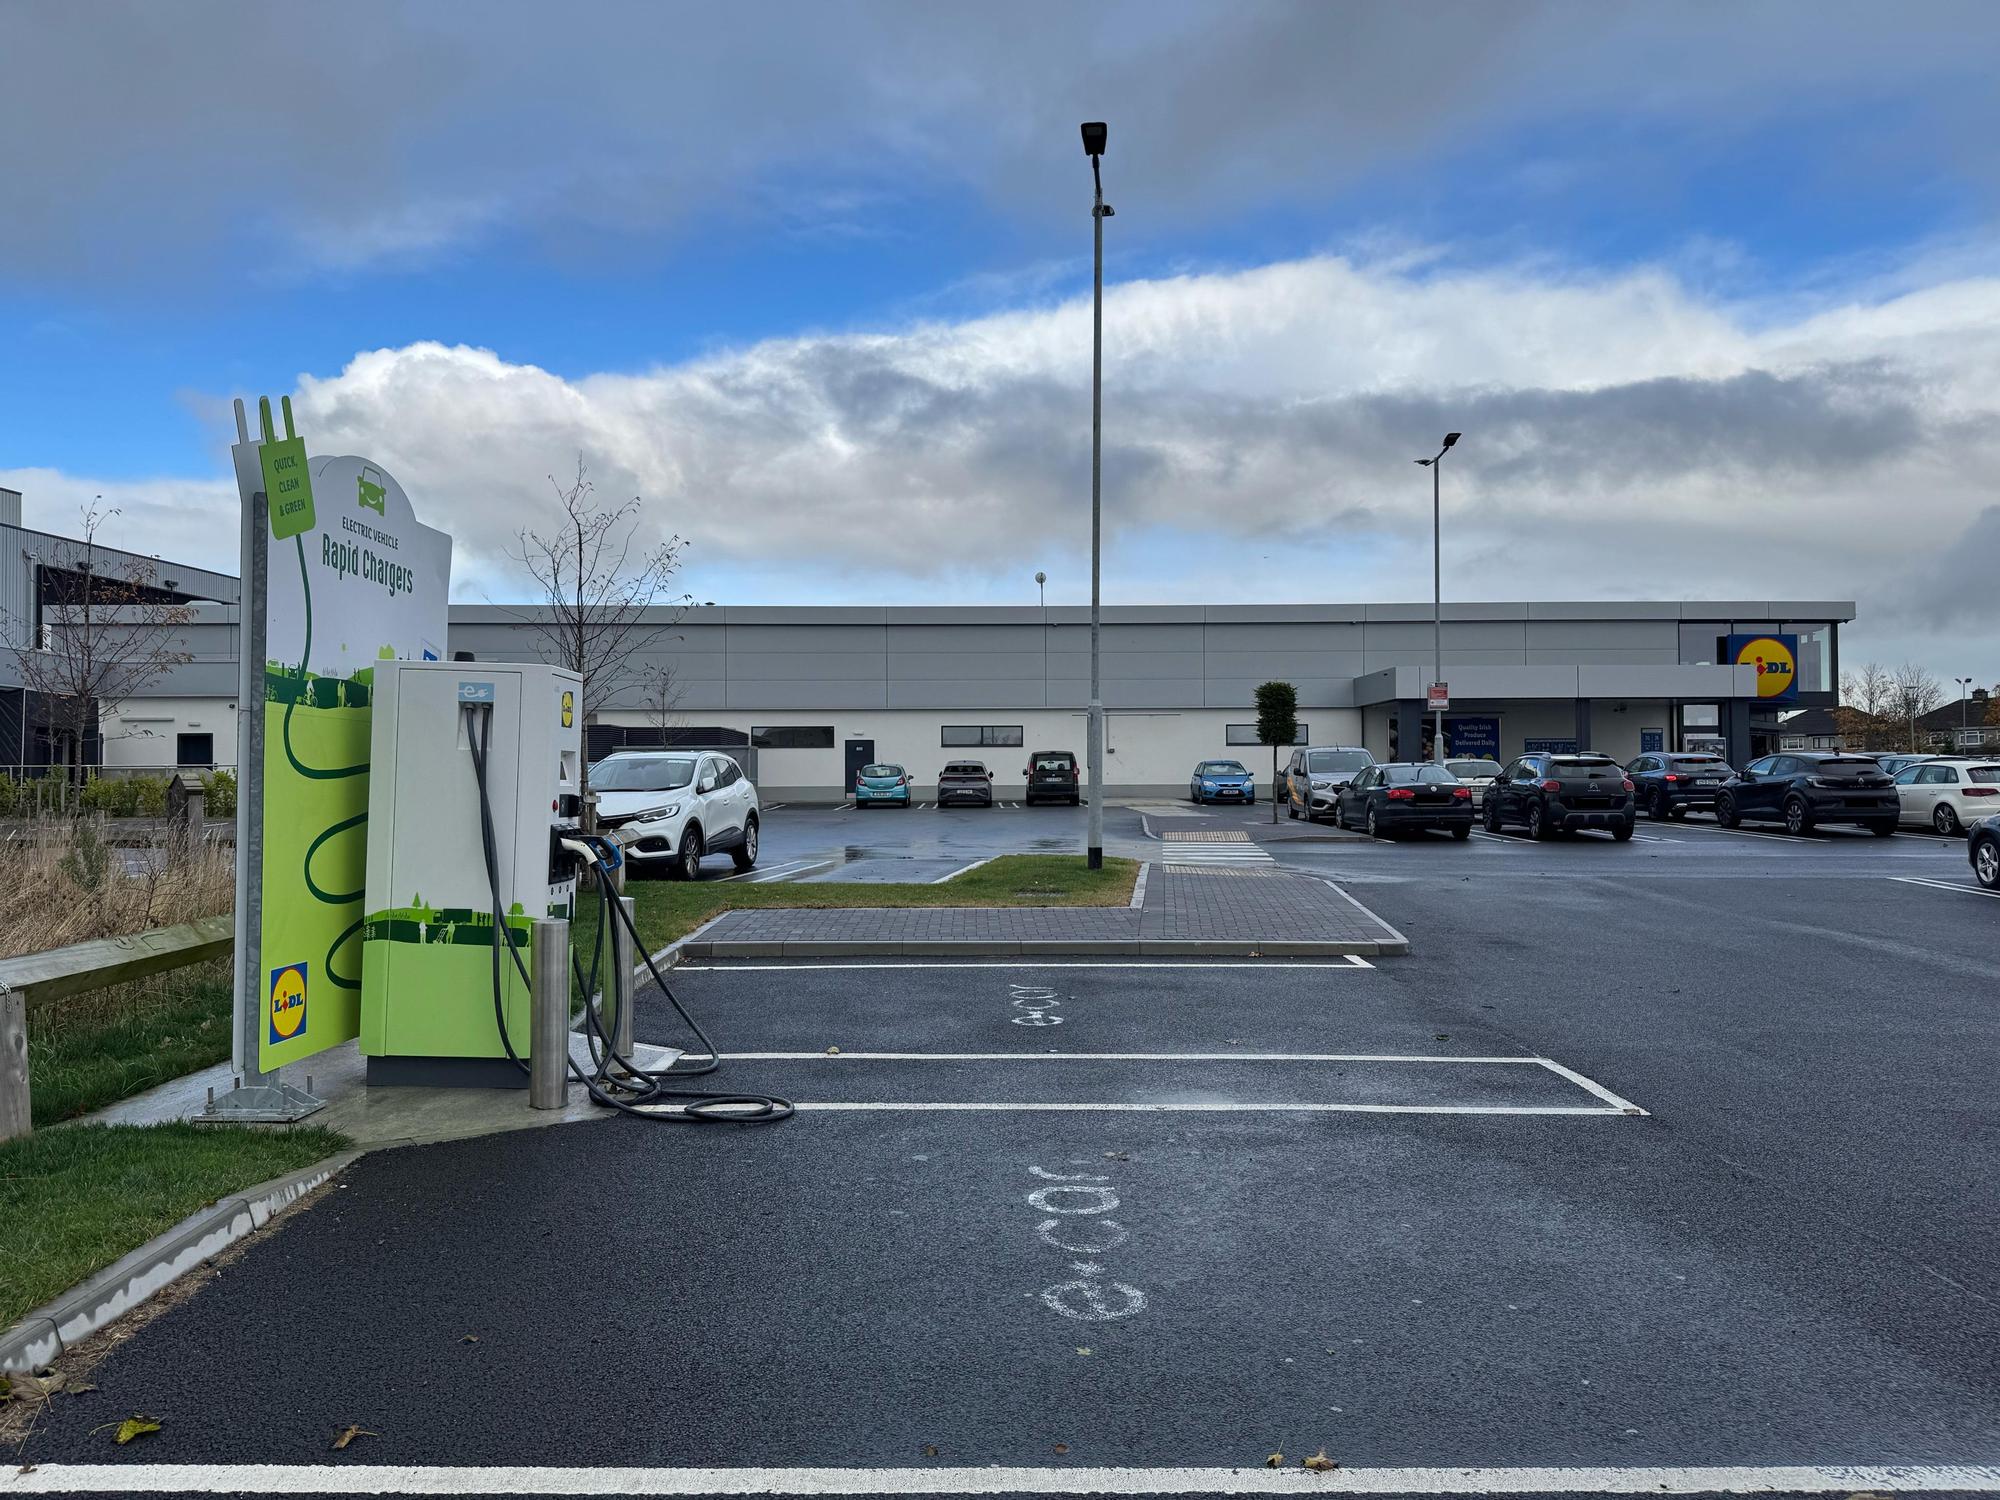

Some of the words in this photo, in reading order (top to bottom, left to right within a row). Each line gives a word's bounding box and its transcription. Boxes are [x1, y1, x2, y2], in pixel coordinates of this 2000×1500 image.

[273, 455, 298, 474] QUICK,
[278, 477, 300, 494] CLEAN
[342, 515, 373, 540] ELECTRIC
[373, 528, 399, 551] VEHICLE
[322, 533, 359, 581] Rapid
[363, 548, 413, 597] Chargers
[1458, 724, 1479, 732] Quality
[1481, 740, 1496, 748] Daily
